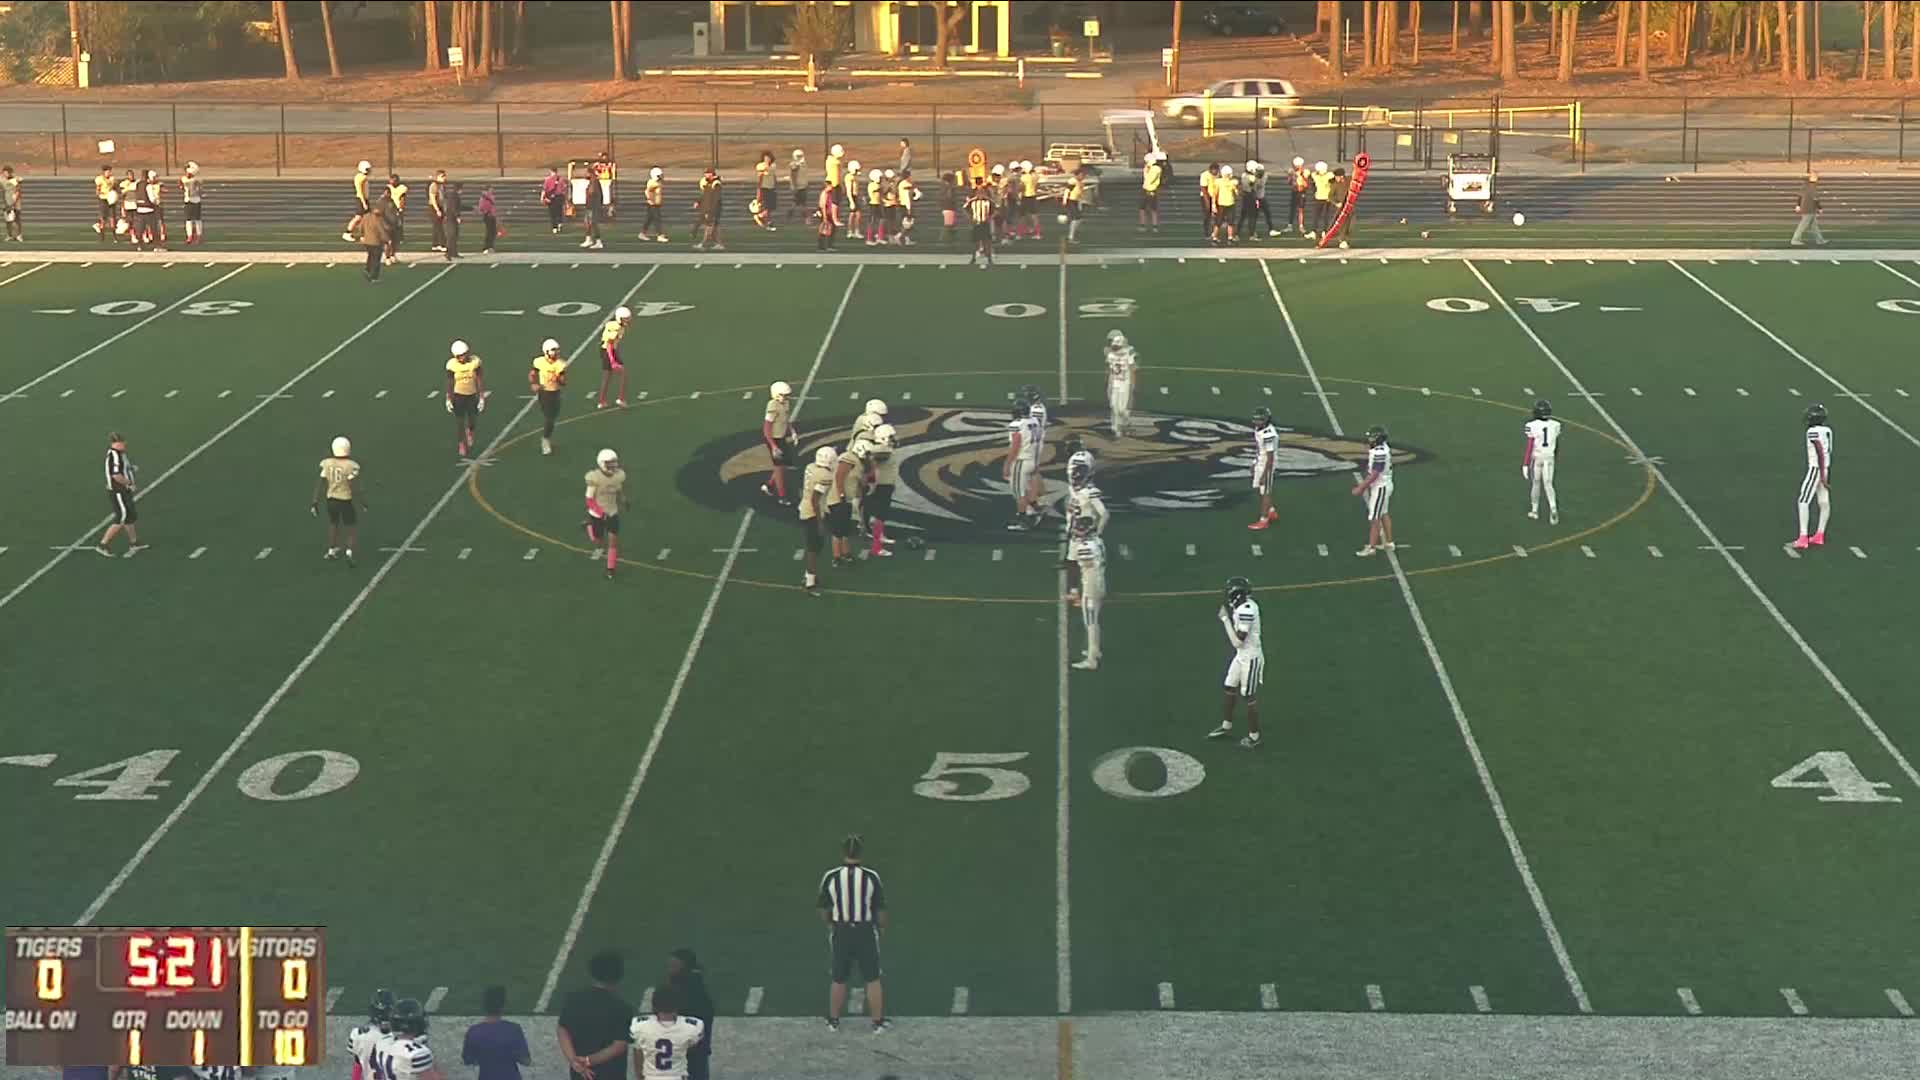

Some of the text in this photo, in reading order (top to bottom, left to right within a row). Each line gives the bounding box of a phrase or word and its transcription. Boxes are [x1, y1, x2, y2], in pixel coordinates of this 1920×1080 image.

[537, 302, 696, 316] 40
[1426, 297, 1580, 313] 40
[1542, 427, 1549, 447] 1
[53, 750, 360, 800] 40
[913, 746, 1206, 801] 50
[1770, 750, 1903, 802] 4
[656, 1038, 672, 1071] 2
